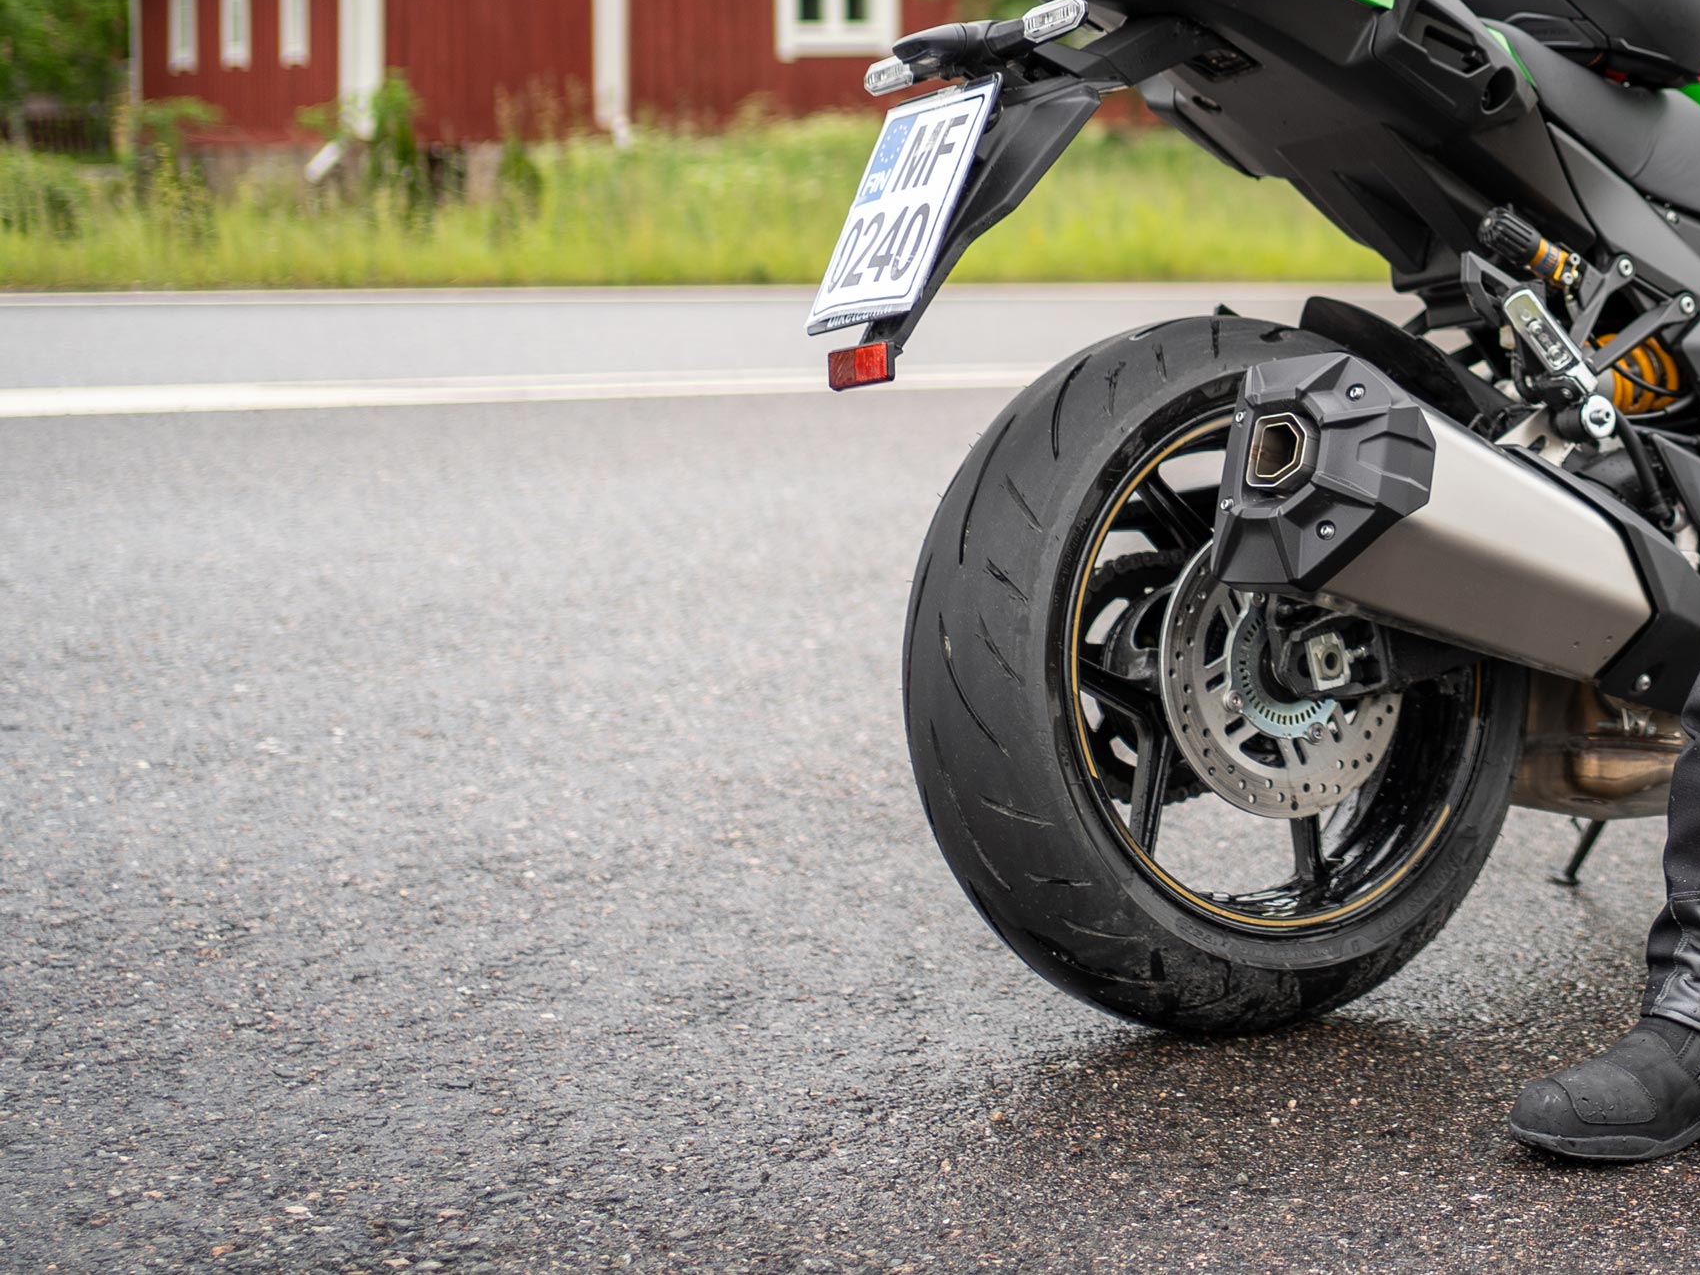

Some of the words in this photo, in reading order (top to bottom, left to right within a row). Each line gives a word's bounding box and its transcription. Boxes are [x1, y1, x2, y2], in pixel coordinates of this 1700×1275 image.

[865, 169, 892, 195] FIN
[891, 114, 969, 194] MF
[827, 202, 931, 294] 0240
